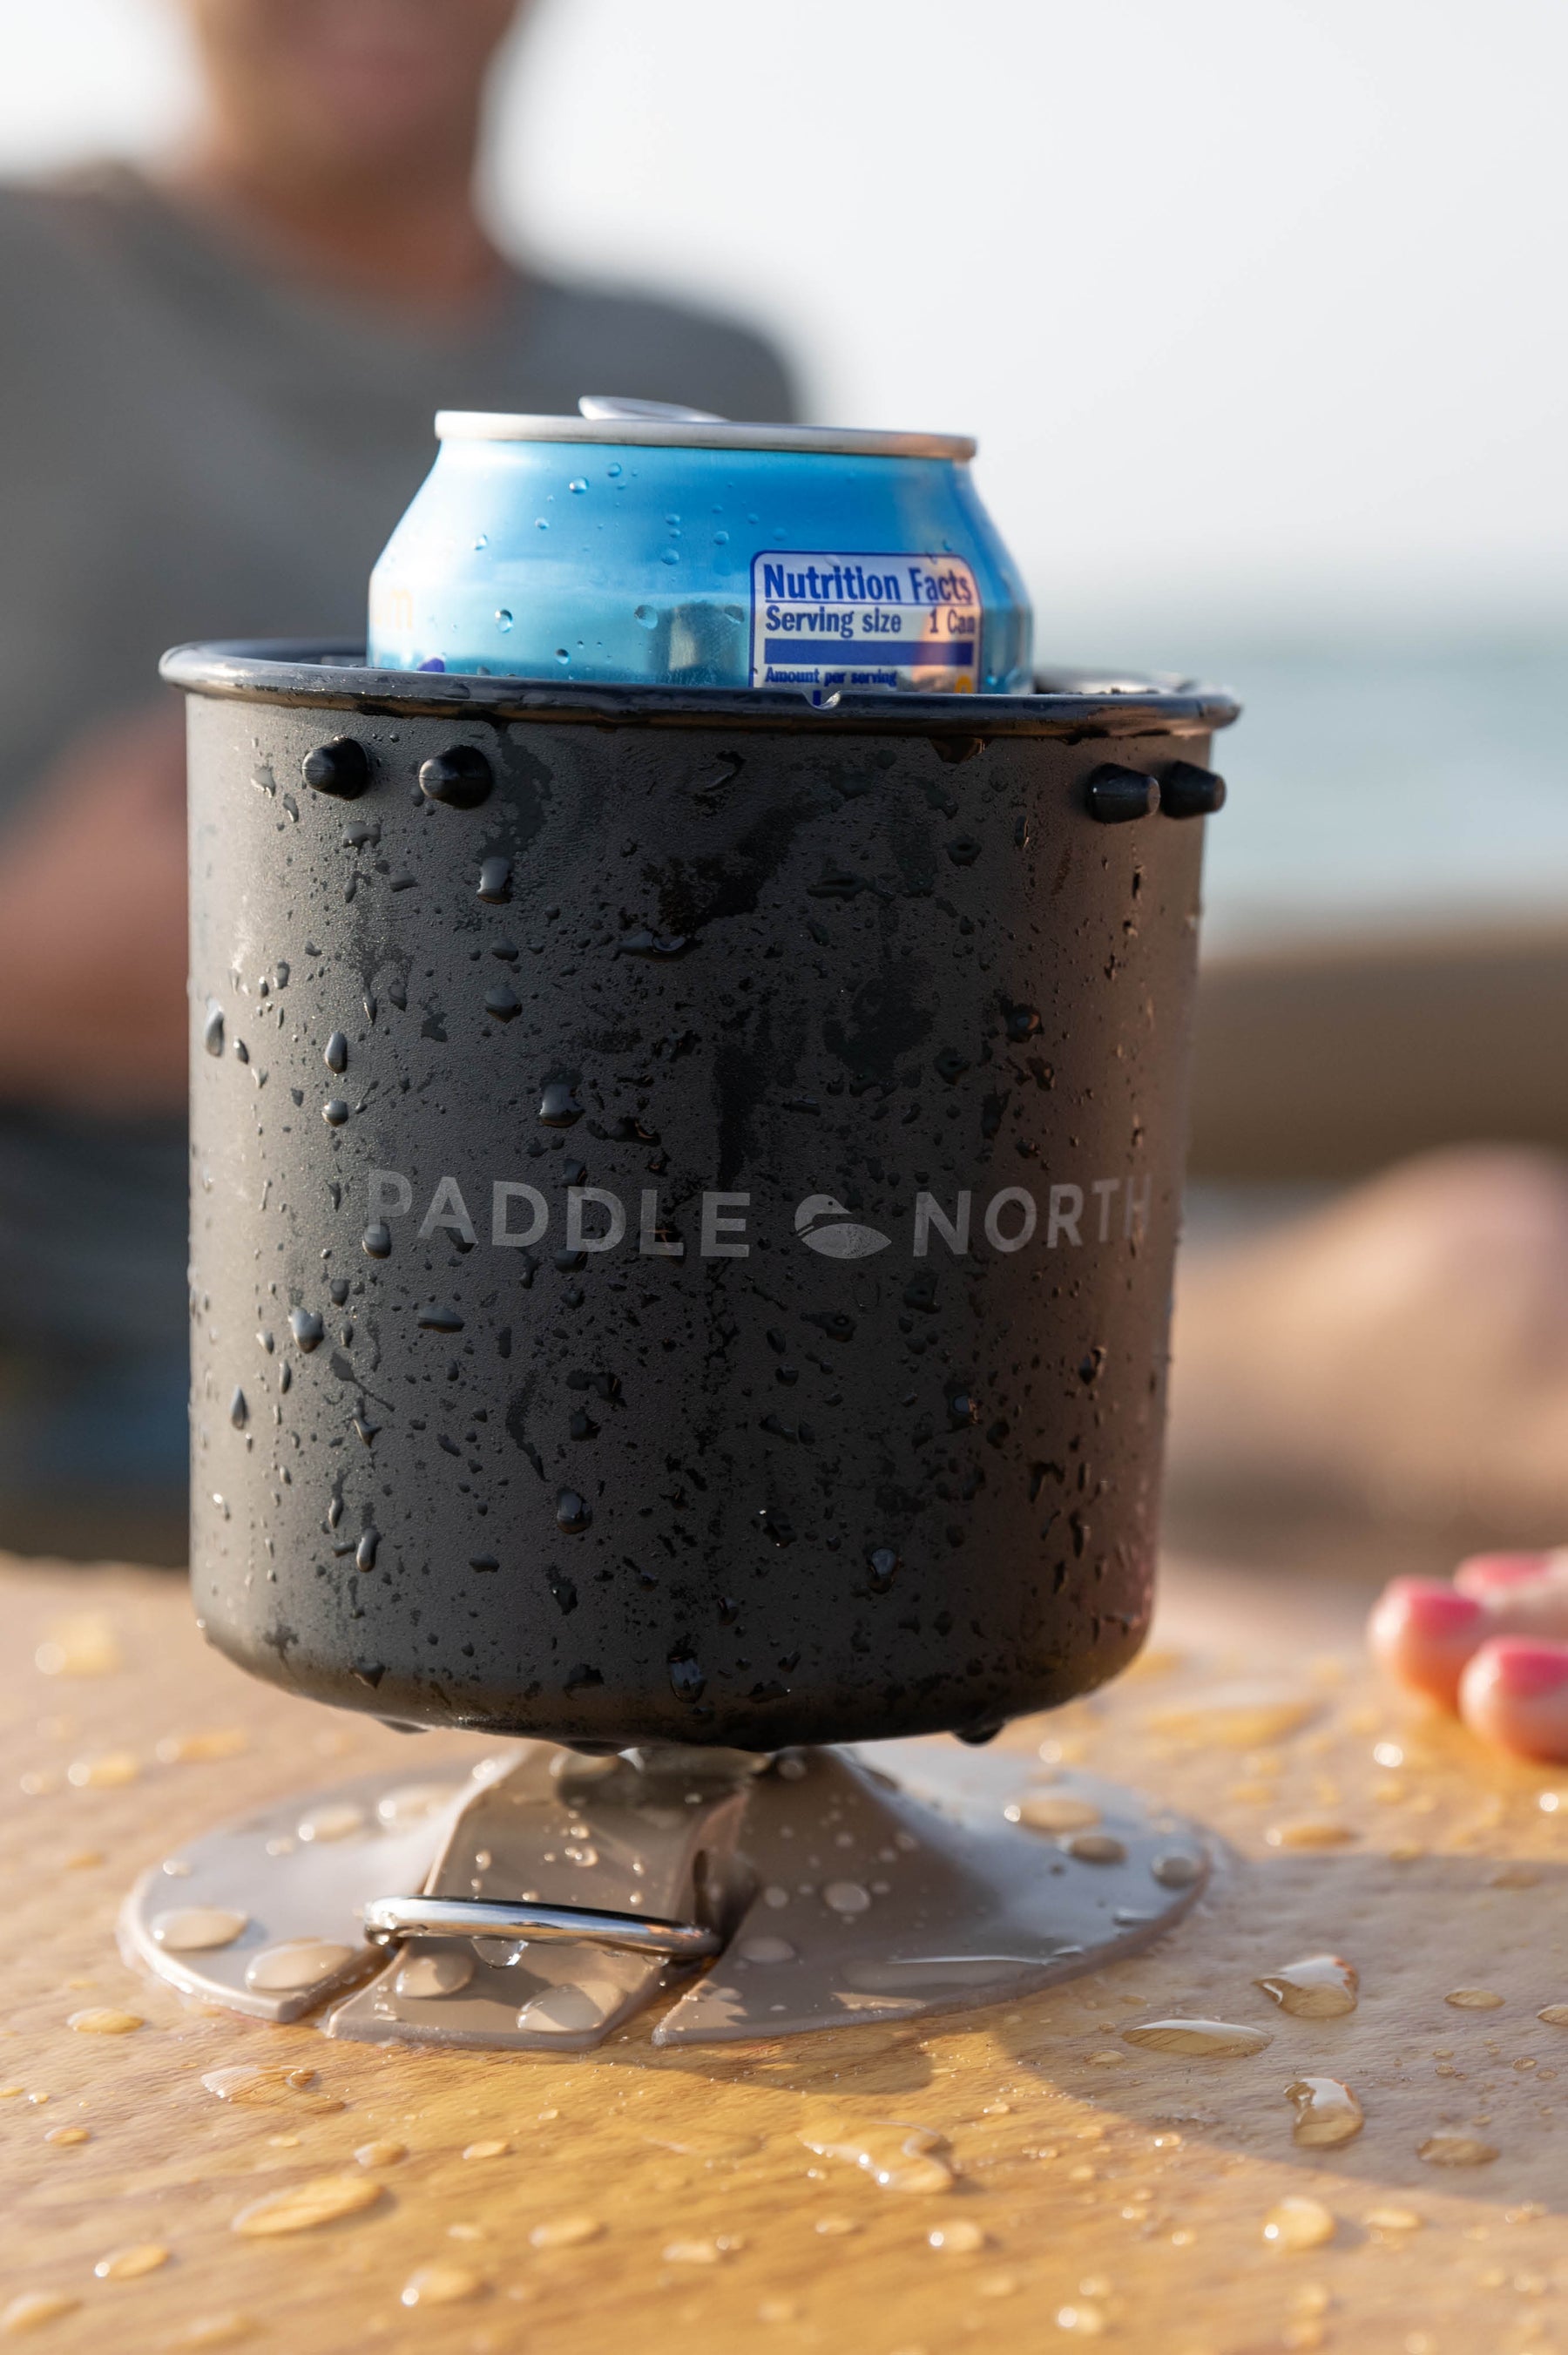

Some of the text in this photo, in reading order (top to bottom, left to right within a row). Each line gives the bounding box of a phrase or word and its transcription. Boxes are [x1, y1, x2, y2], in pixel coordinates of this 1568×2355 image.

[763, 564, 973, 603] Nutrition Facts
[765, 605, 975, 639] Serving size 1 Can
[765, 667, 897, 687] Amount per serving
[367, 1168, 1152, 1258] PADDLE NORTH
